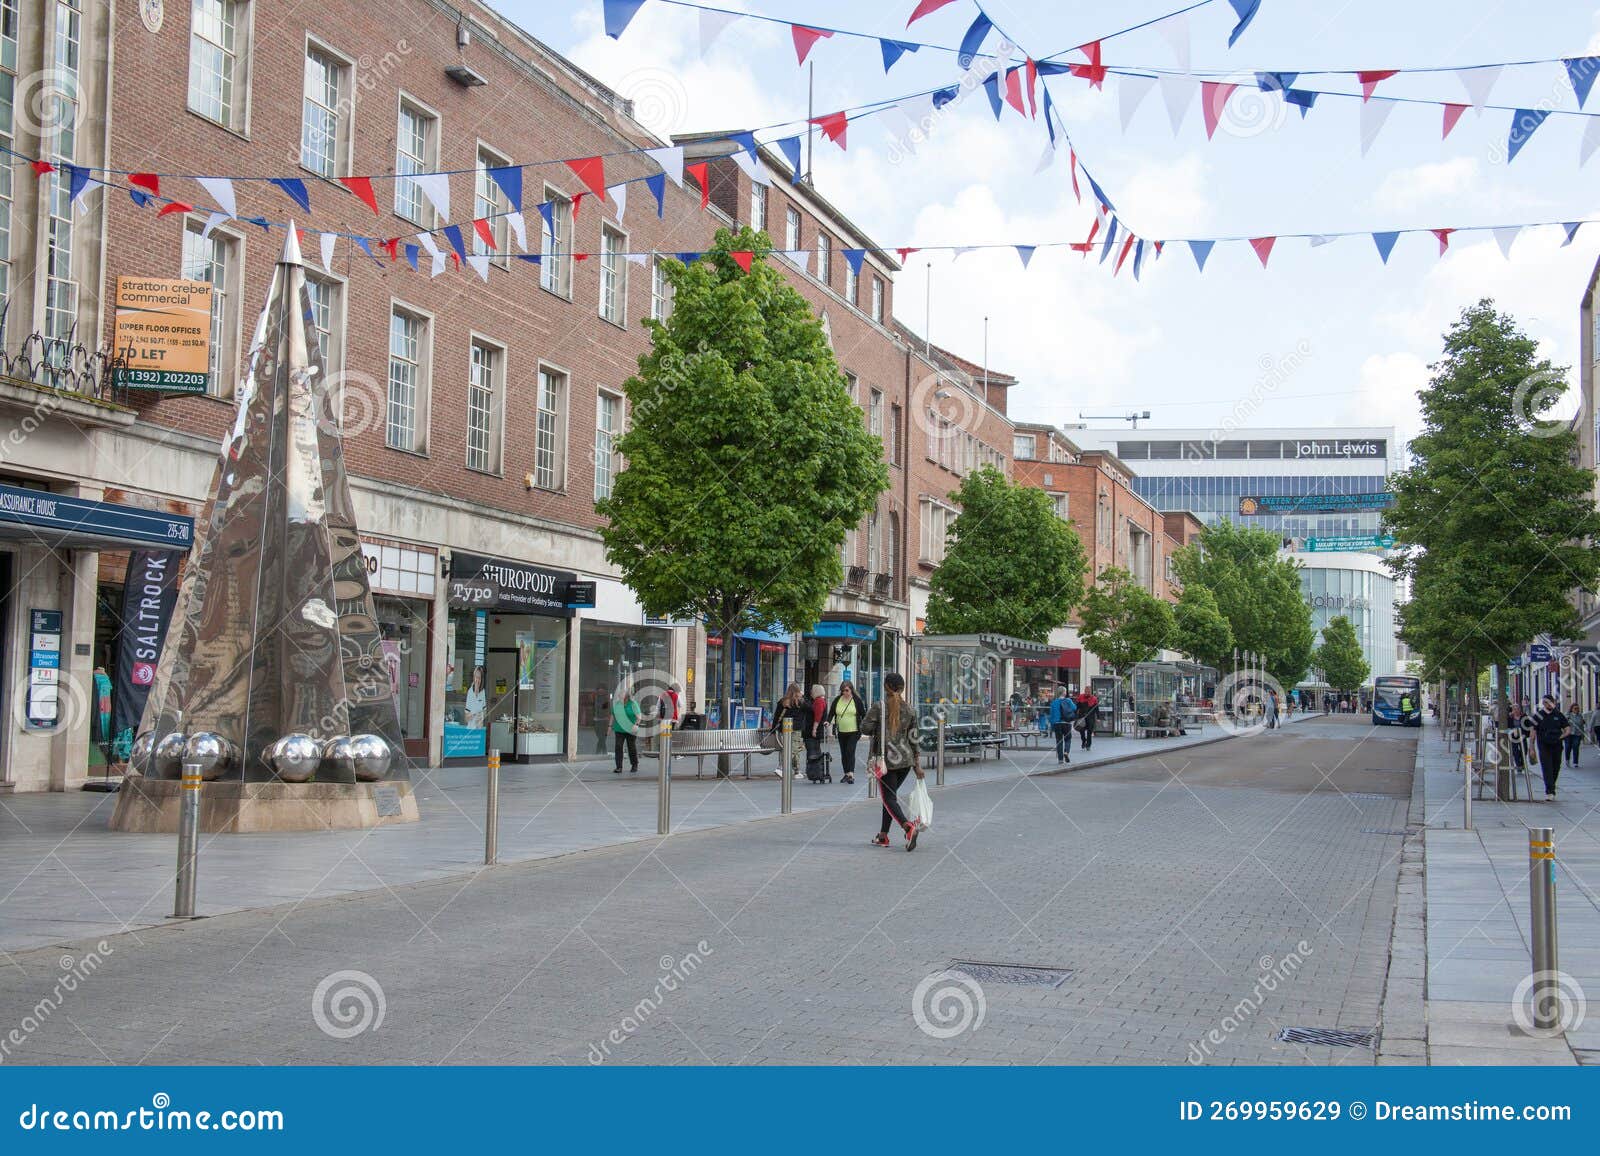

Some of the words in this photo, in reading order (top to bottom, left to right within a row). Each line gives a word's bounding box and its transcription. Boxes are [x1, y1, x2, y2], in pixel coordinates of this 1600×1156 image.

[122, 281, 167, 292] stratton
[171, 283, 211, 294] creber
[121, 293, 190, 304] commercial
[119, 323, 144, 331] UPPER
[146, 325, 170, 333] FLOOR
[171, 326, 201, 335] OFFICES
[118, 347, 137, 358] TO
[141, 349, 167, 360] LET
[163, 373, 205, 385] 202203
[1295, 441, 1330, 459] John
[1335, 441, 1377, 455] Lewis
[36, 499, 58, 517] HOUSE
[482, 564, 556, 595] SHUROPODY
[453, 583, 492, 602] Typo
[499, 592, 511, 600] rivate
[136, 558, 167, 660] SALTROCK
[32, 652, 58, 660] Ultrasound
